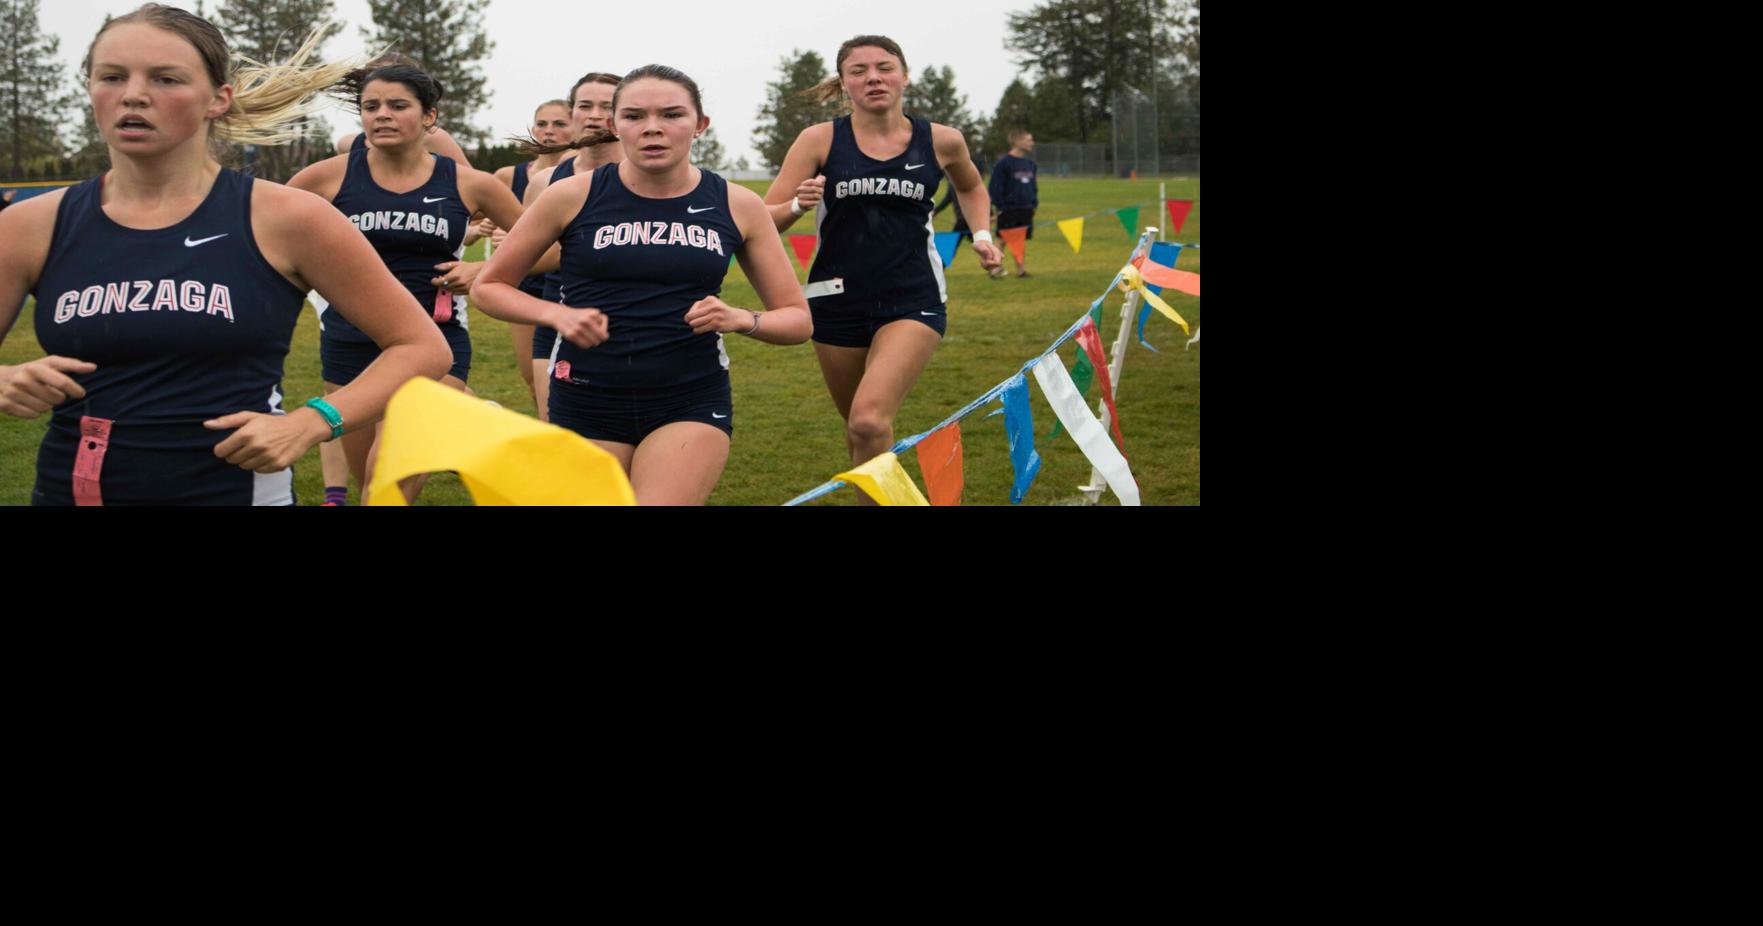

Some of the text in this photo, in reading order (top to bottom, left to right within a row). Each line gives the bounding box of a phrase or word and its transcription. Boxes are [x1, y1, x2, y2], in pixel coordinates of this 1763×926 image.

[835, 177, 925, 200] GONZAGA
[593, 221, 725, 256] GONZAGA
[54, 279, 234, 323] GONZAGA
